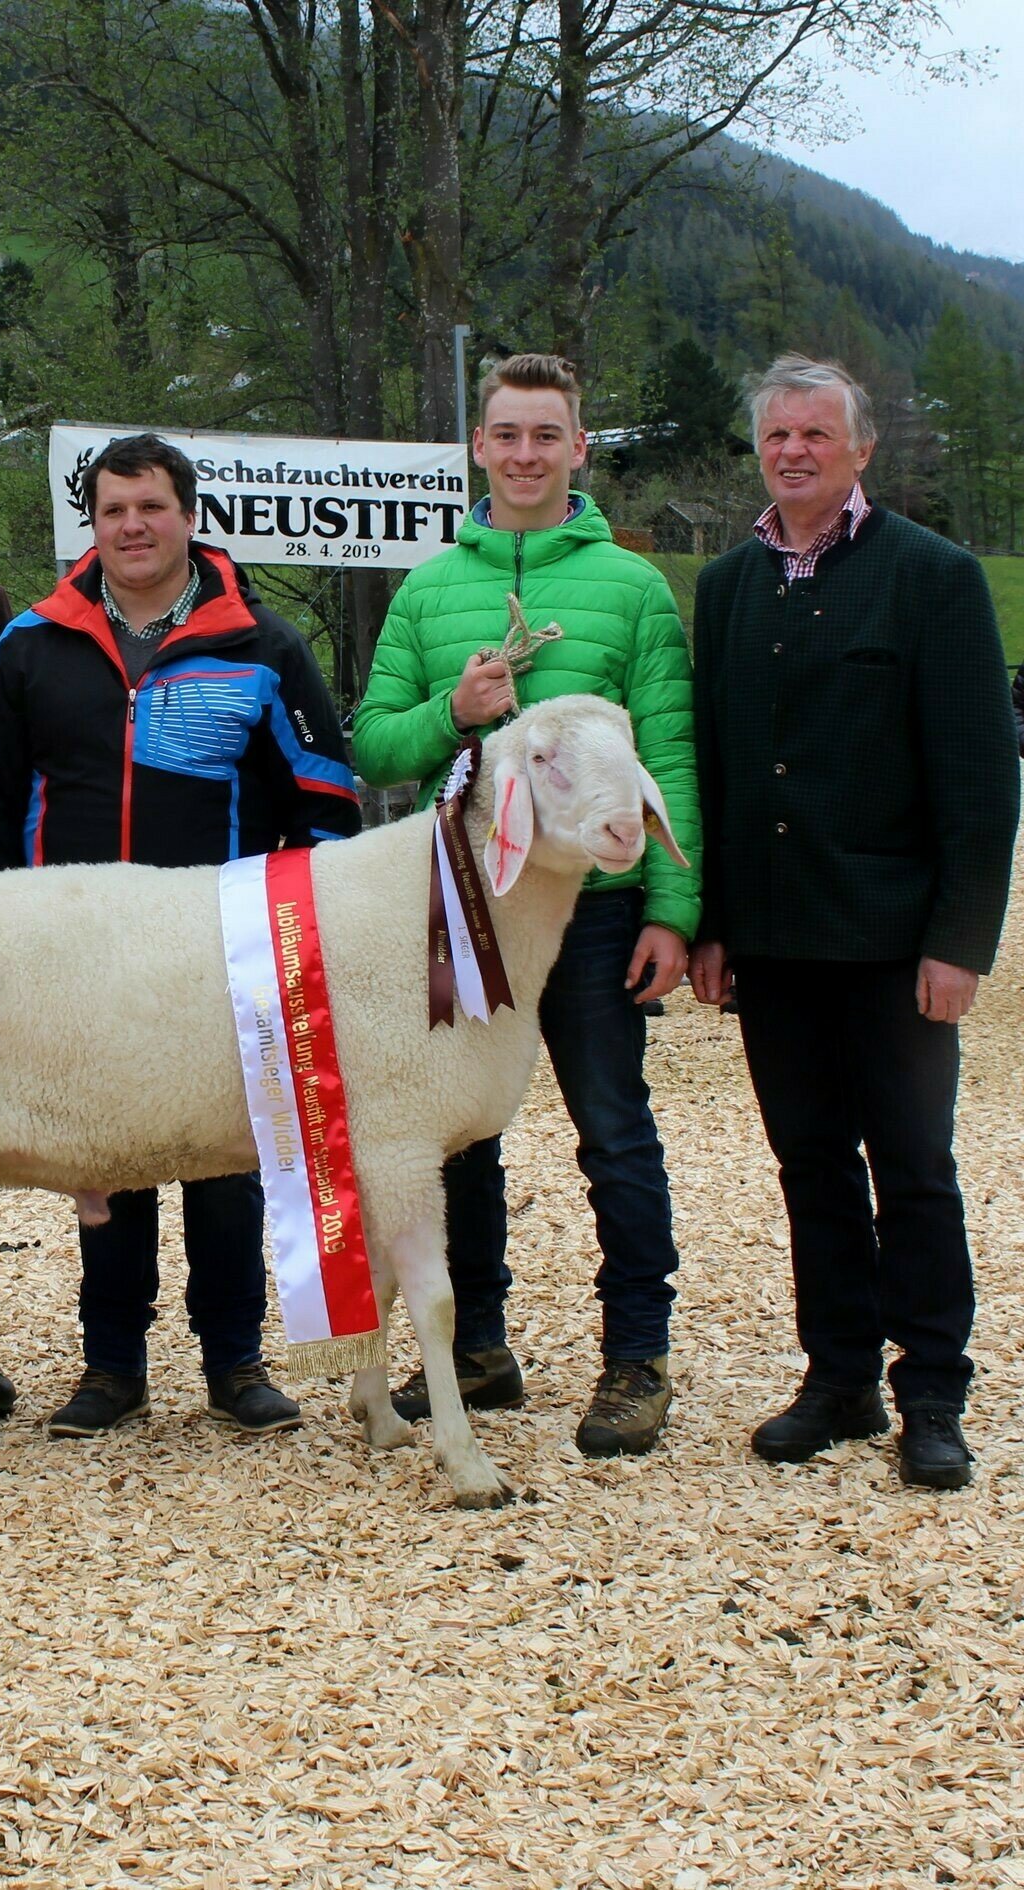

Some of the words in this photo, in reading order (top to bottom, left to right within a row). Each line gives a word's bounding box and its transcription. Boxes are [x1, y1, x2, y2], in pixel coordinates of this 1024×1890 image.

[195, 458, 464, 493] Schafzuchtverein
[197, 493, 465, 544] NEUSTIFT
[285, 542, 311, 557] 28.
[319, 544, 334, 557] 4.
[342, 544, 381, 559] 2019
[294, 709, 311, 735] etirel
[459, 935, 471, 960] SIEGER
[478, 932, 491, 951] 2019
[276, 901, 317, 1073] Jubiläumsausstellung
[251, 985, 284, 1103] Gesamtsieger
[271, 1110, 296, 1174] Widder
[302, 1075, 327, 1127] Neustift
[309, 1127, 328, 1145] im
[313, 1147, 339, 1207] Stubaital
[321, 1209, 346, 1254] 2019
